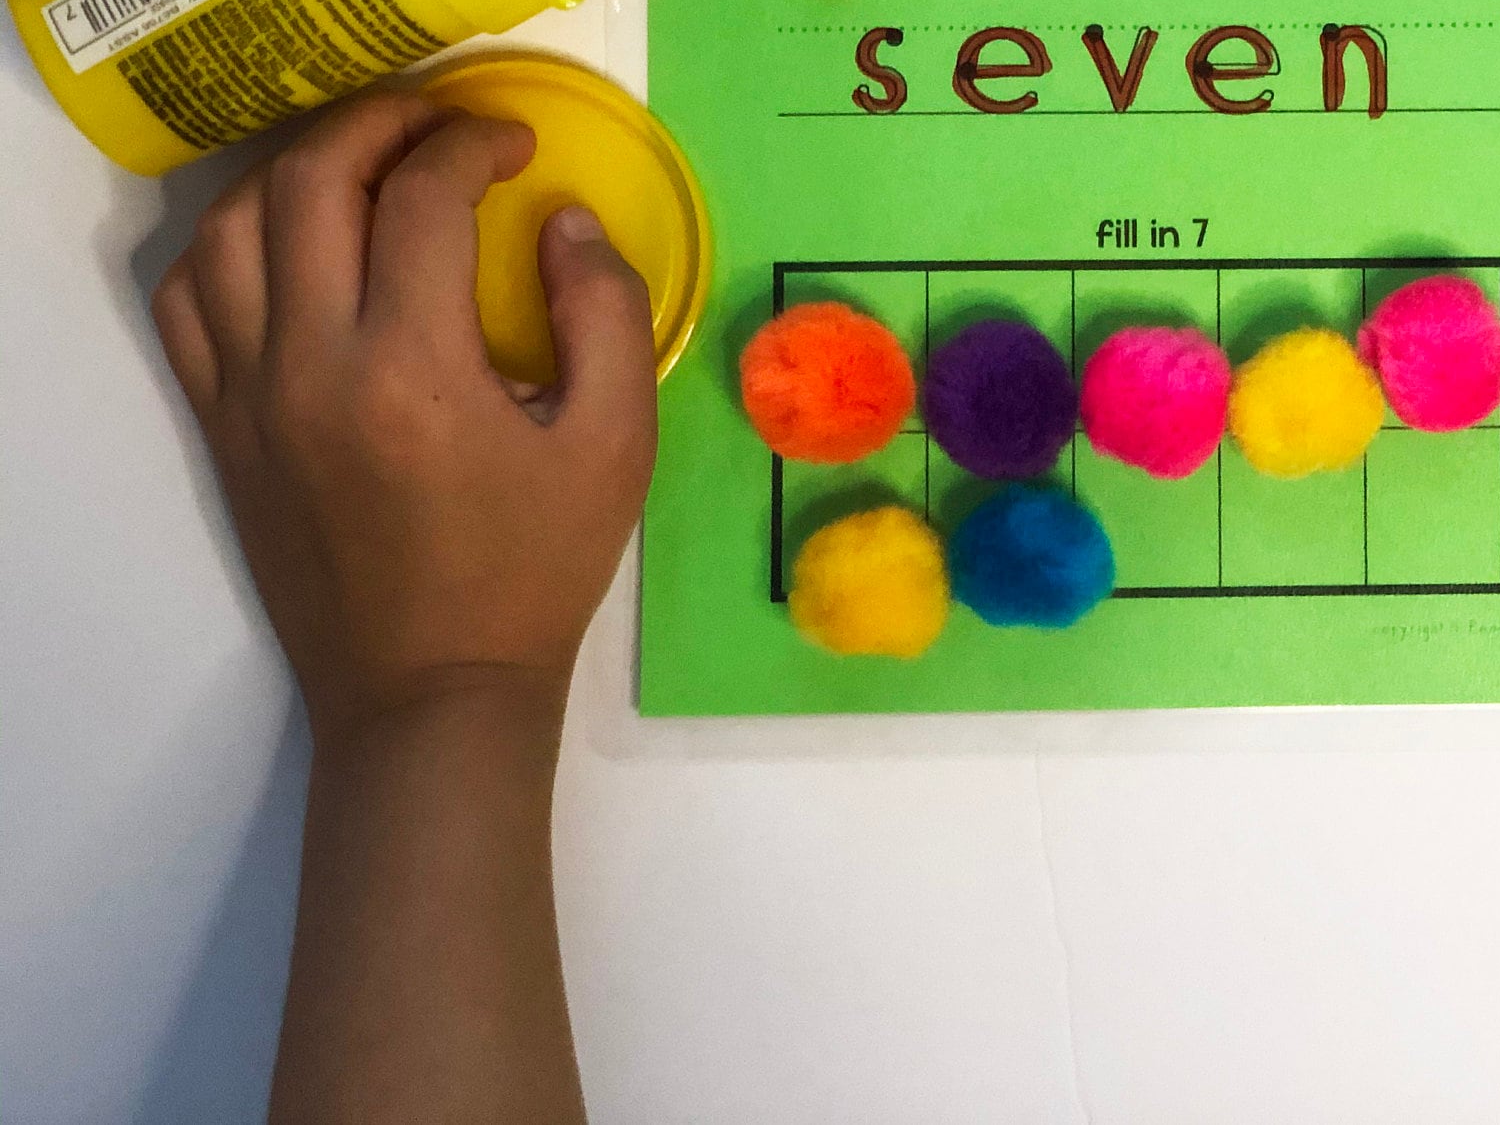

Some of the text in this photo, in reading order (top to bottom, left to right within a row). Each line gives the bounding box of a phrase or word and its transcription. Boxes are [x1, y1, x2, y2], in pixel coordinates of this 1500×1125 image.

[852, 24, 1387, 120] seven
[1096, 219, 1209, 249] fill in 7
